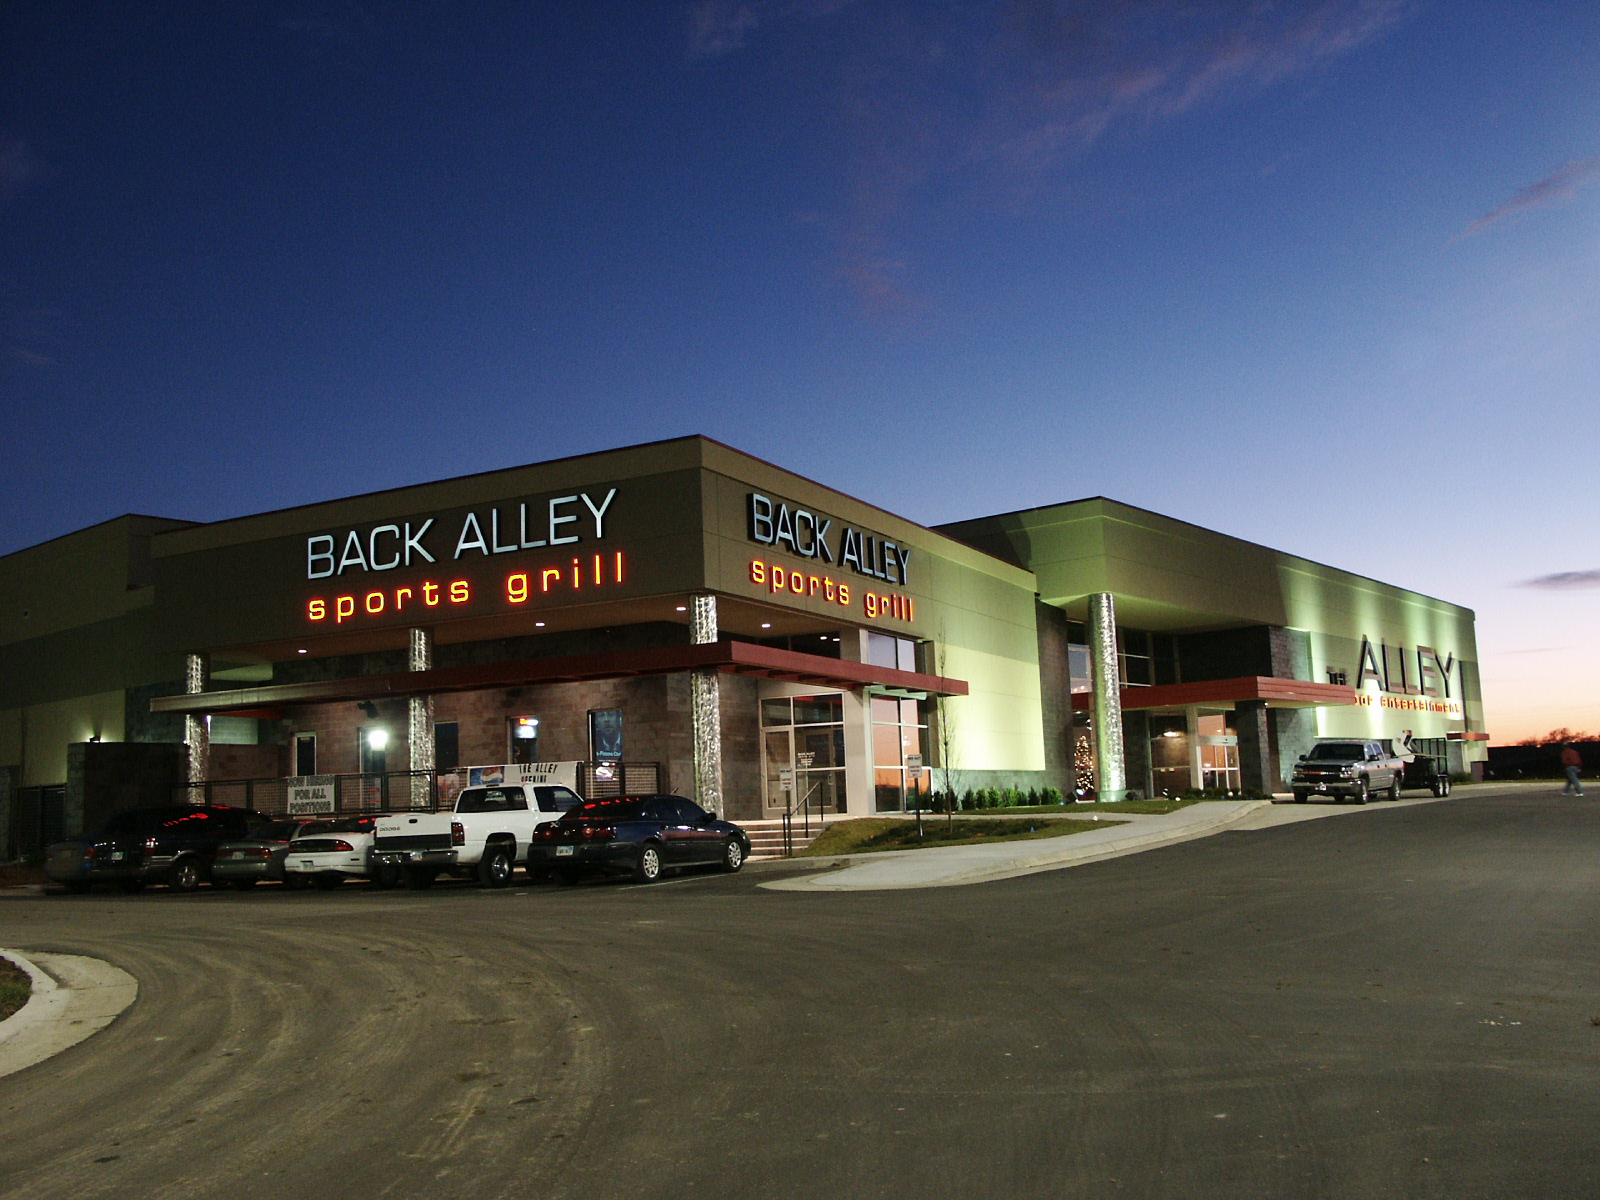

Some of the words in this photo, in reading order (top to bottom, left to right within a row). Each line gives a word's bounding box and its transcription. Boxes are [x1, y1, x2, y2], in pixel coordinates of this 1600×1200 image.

[307, 518, 436, 580] BACK
[454, 488, 617, 560] ALLEY
[748, 493, 834, 562] BACK
[839, 528, 911, 586] ALLEY
[308, 579, 470, 624] sports
[507, 551, 624, 603] grill
[750, 560, 850, 606] sports
[864, 591, 915, 622] grill
[1356, 636, 1456, 698] ALLEY
[1381, 696, 1461, 713] entertainment
[311, 788, 327, 799] ALL
[519, 764, 532, 774] THE
[535, 763, 558, 774] ALLEY
